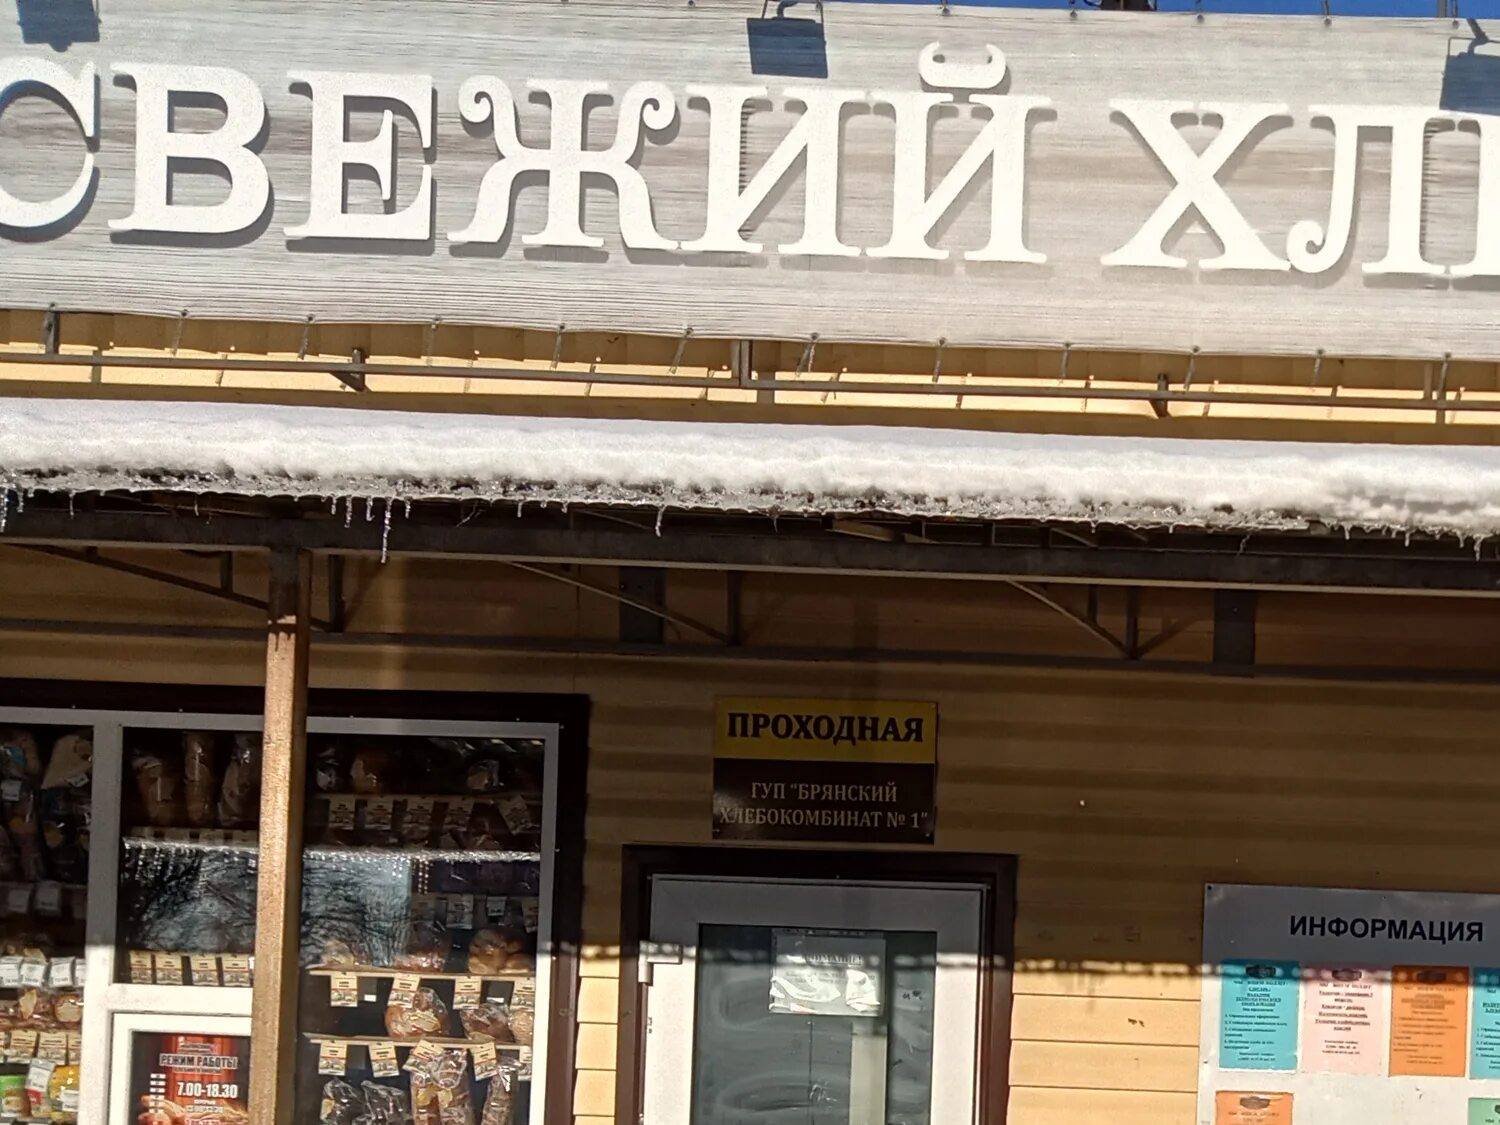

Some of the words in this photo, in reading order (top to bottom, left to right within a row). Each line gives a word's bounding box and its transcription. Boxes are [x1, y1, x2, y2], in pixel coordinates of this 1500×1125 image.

[727, 712, 924, 746] ПРОХОДНАЯ
[751, 782, 786, 800] ГУП
[790, 781, 898, 803] "БРЯНСКИЙ
[719, 806, 883, 828] ХЛЕБОКОМБИНАТ
[886, 811, 906, 828] №
[910, 811, 928, 829] 1"
[1289, 914, 1484, 945] ИНФОРМАЦИЯ
[160, 1053, 195, 1068] РЕЖИМ
[177, 1082, 238, 1099] 7.00-18.30
